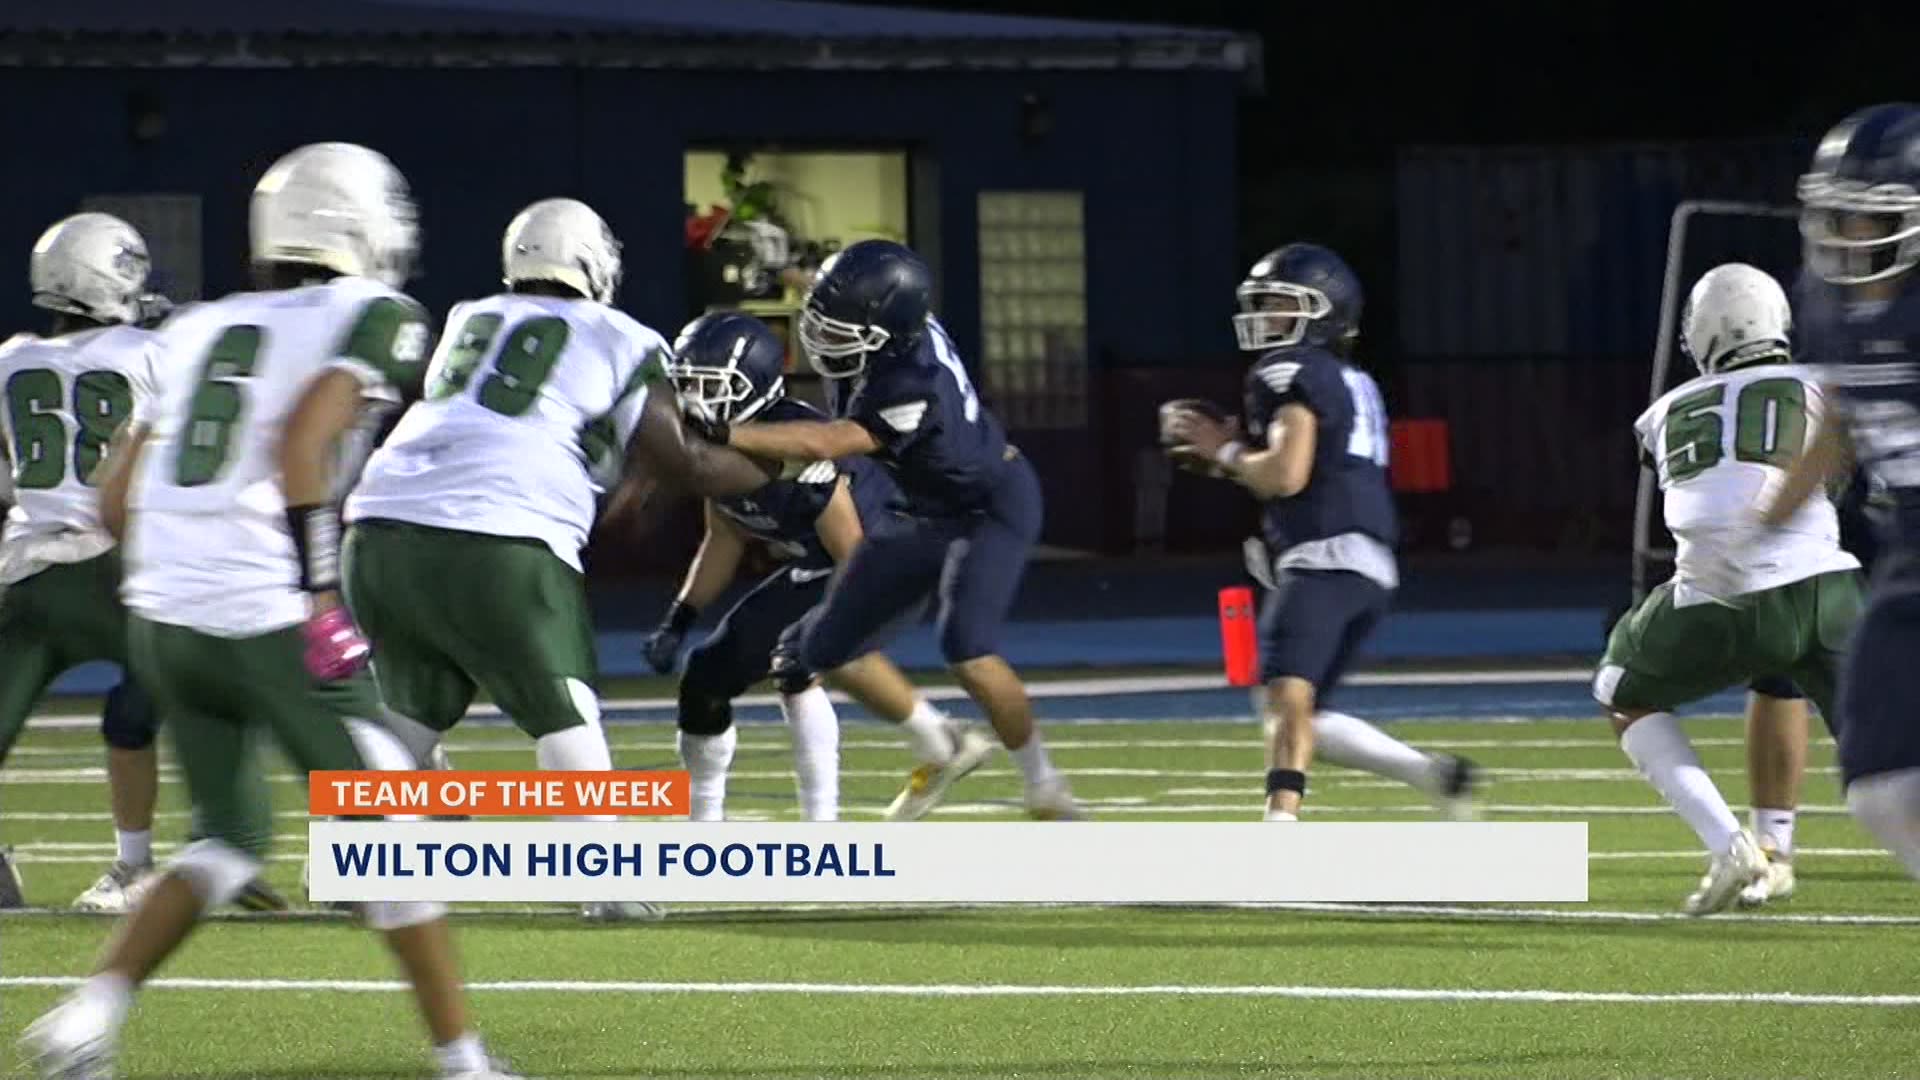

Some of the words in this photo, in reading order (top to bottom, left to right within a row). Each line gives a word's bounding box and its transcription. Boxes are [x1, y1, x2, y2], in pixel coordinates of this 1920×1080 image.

[6, 368, 133, 488] 68
[176, 323, 266, 488] 6
[1666, 377, 1806, 482] 50
